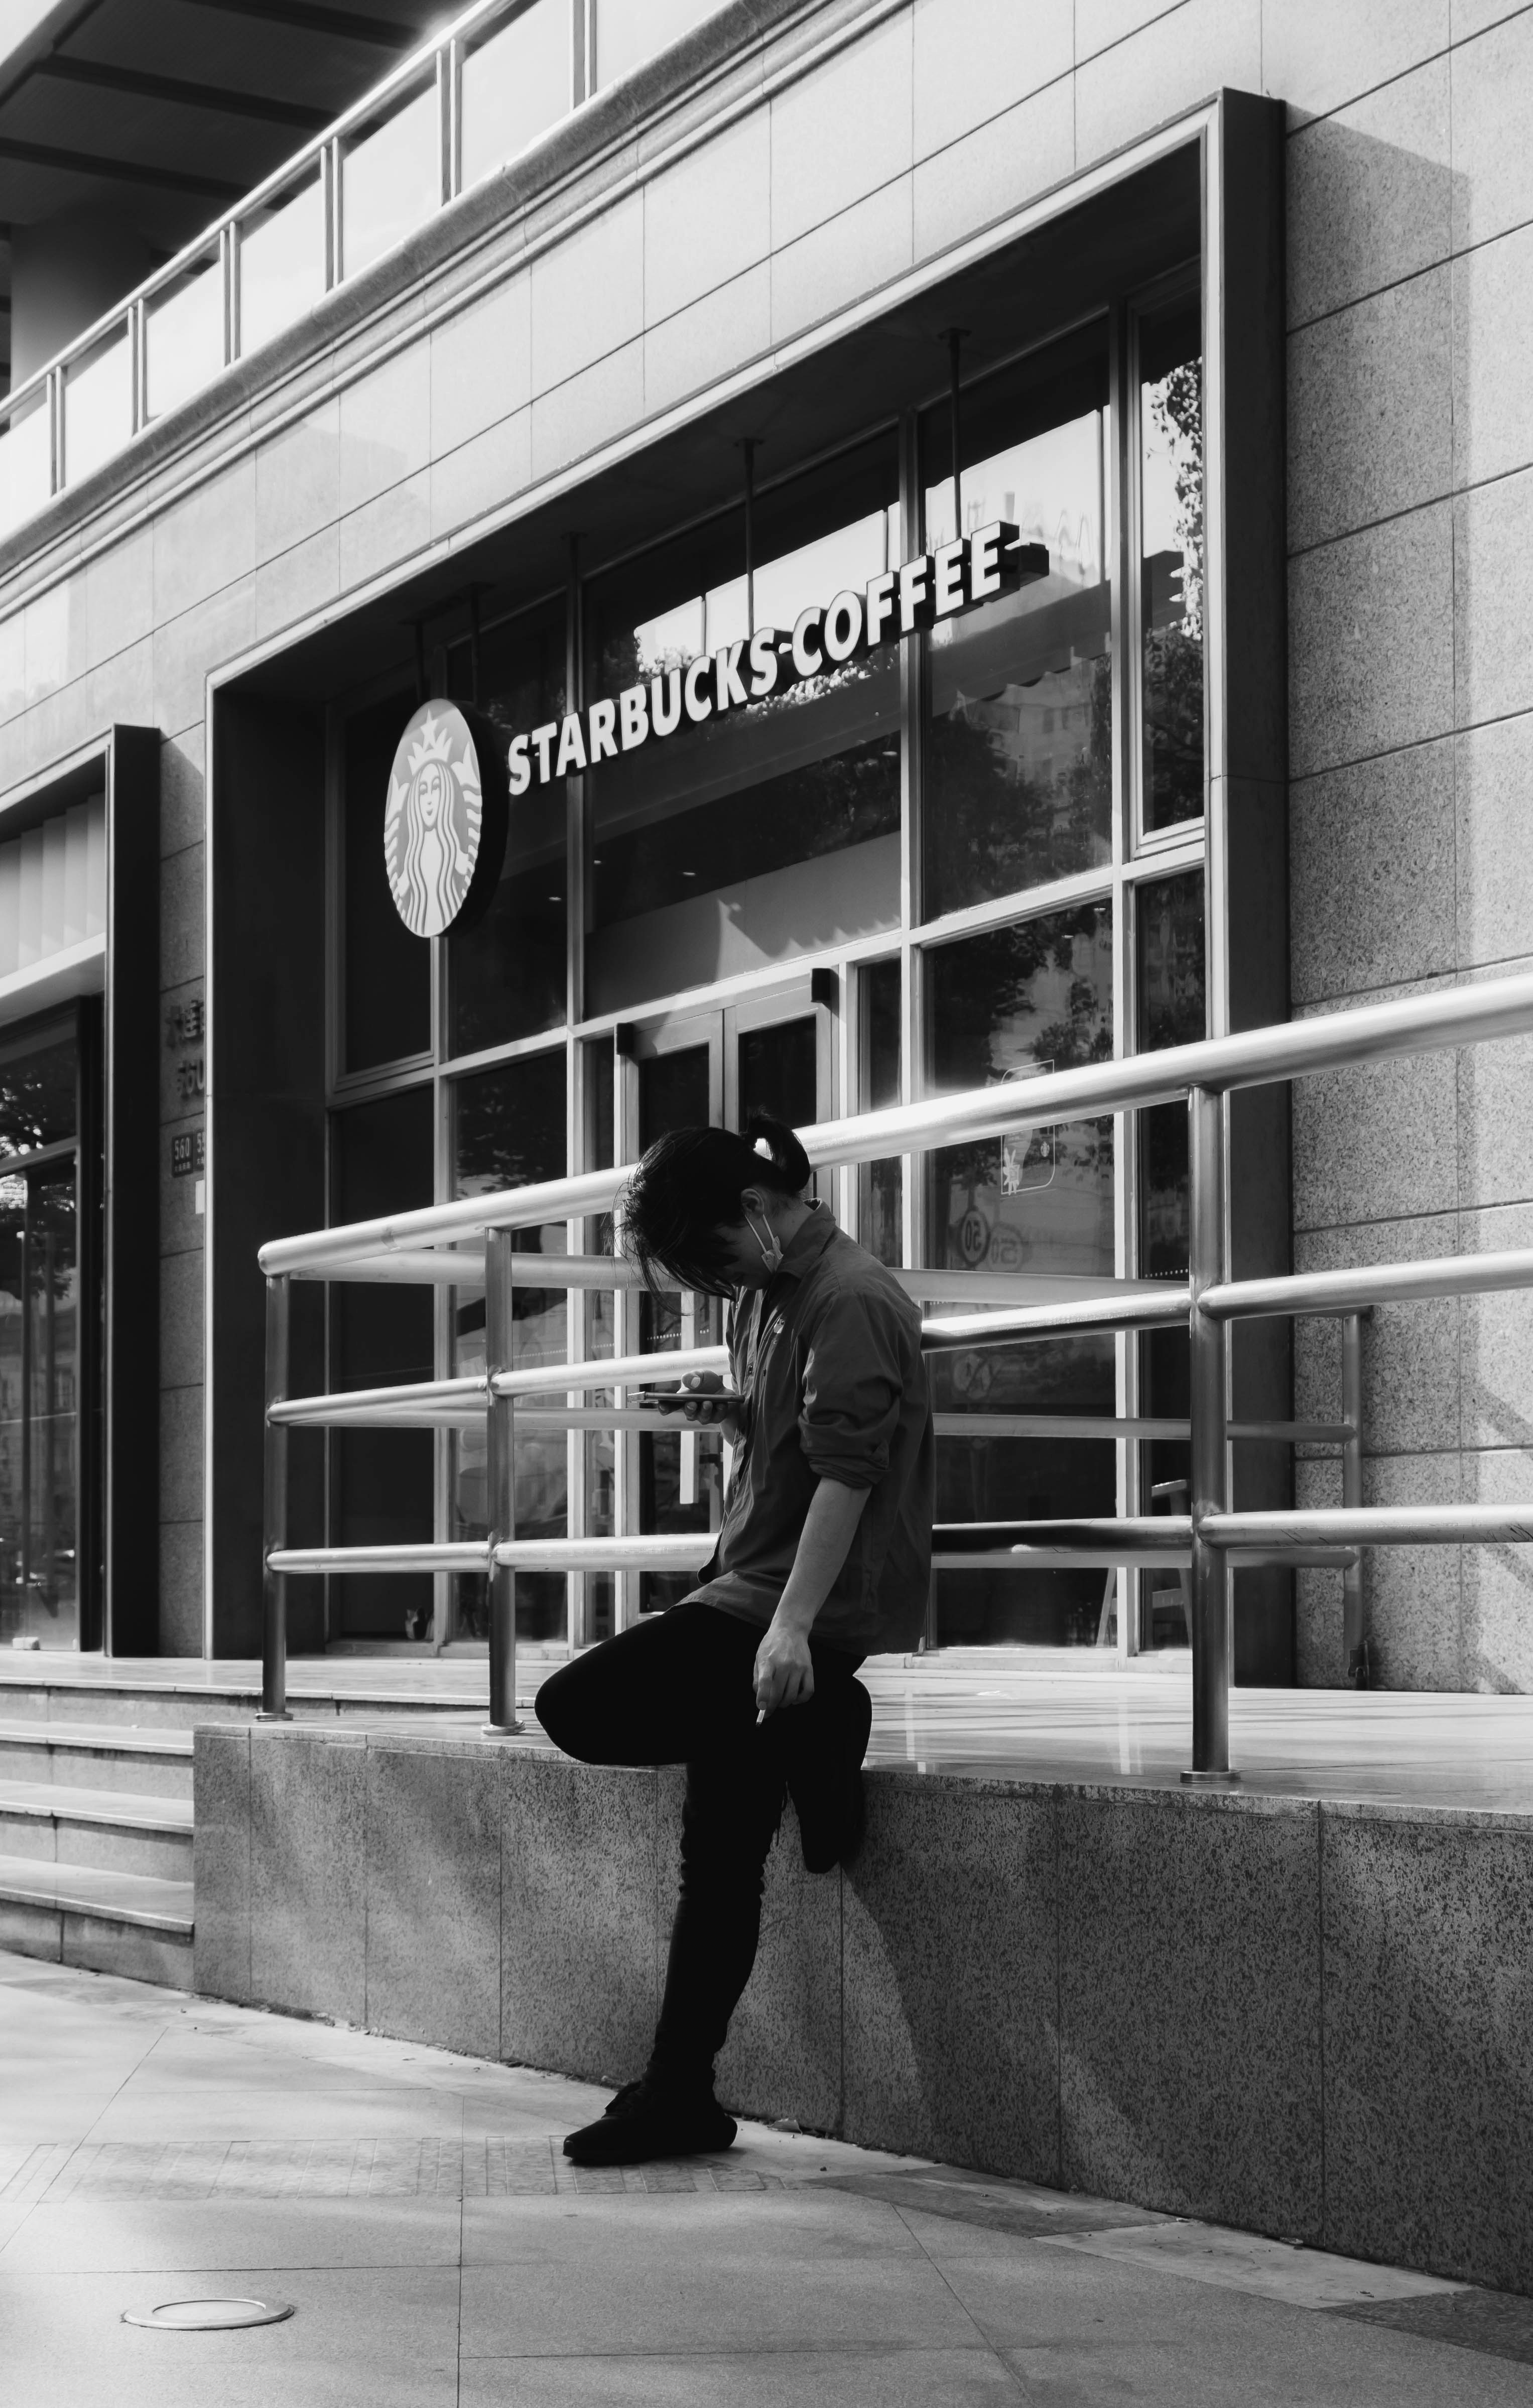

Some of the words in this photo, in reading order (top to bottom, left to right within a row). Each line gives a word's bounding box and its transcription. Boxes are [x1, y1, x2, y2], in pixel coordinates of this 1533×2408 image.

[508, 627, 778, 795] STARBUCKS
[792, 520, 1001, 677] COFFEE
[175, 1136, 190, 1161] 560
